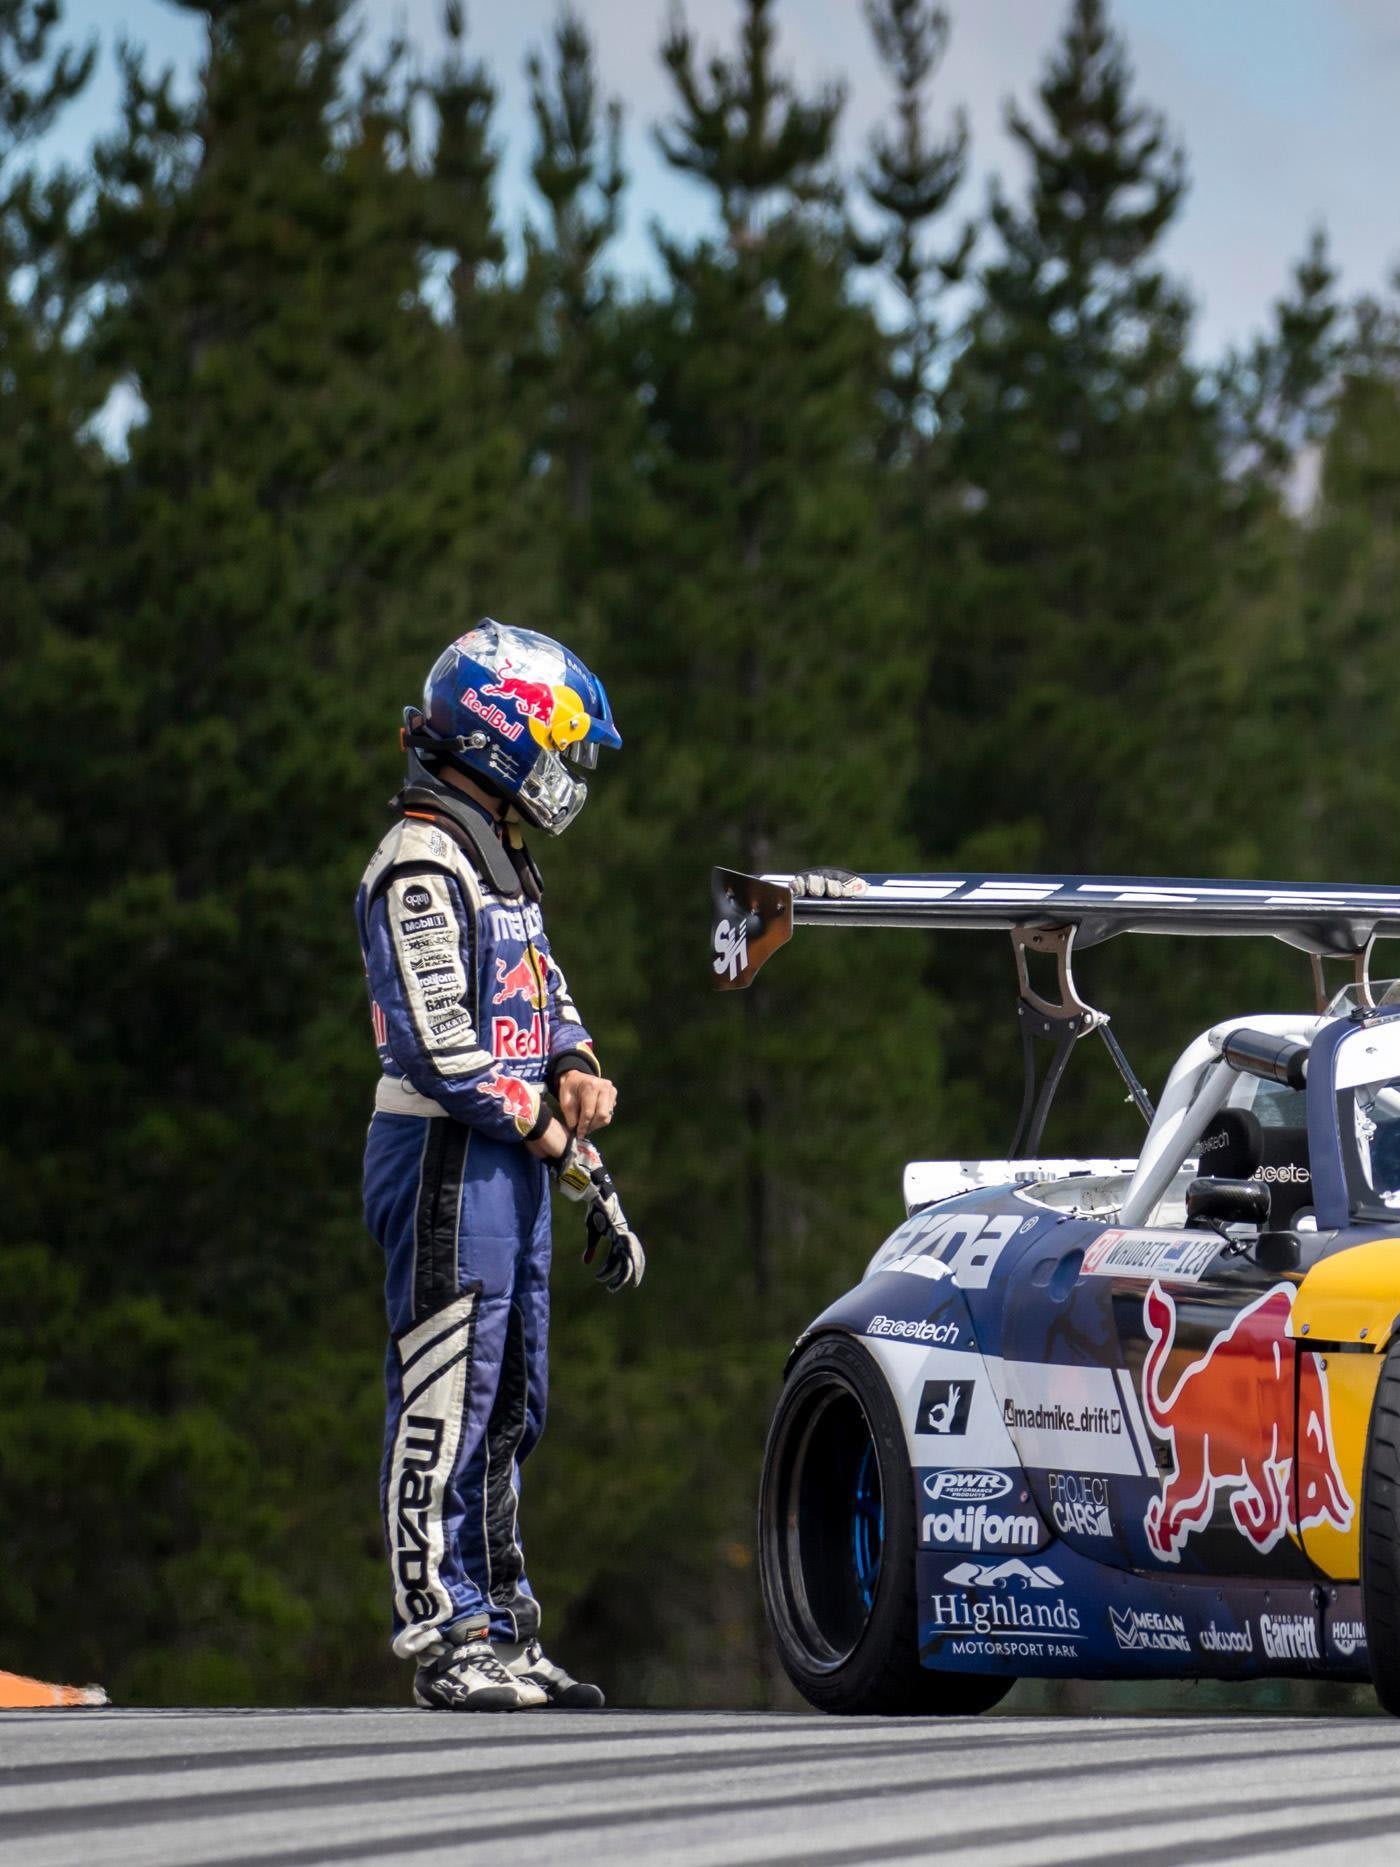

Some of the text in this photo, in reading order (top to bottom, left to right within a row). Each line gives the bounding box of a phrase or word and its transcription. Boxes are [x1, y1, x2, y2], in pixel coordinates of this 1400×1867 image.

[492, 1012, 542, 1059] Red
[867, 1315, 960, 1345] Racetech
[931, 1474, 1003, 1495] PWR
[1048, 1474, 1109, 1505] PROJECT
[923, 1505, 1039, 1550] rotiform
[1053, 1501, 1100, 1536] CARS
[931, 1593, 1081, 1634] Highlands
[1133, 1611, 1184, 1632] MEGAN
[952, 1641, 1078, 1657] MOTORSPORT PARK
[1139, 1632, 1191, 1652] RACING
[1260, 1613, 1320, 1658] Garrett
